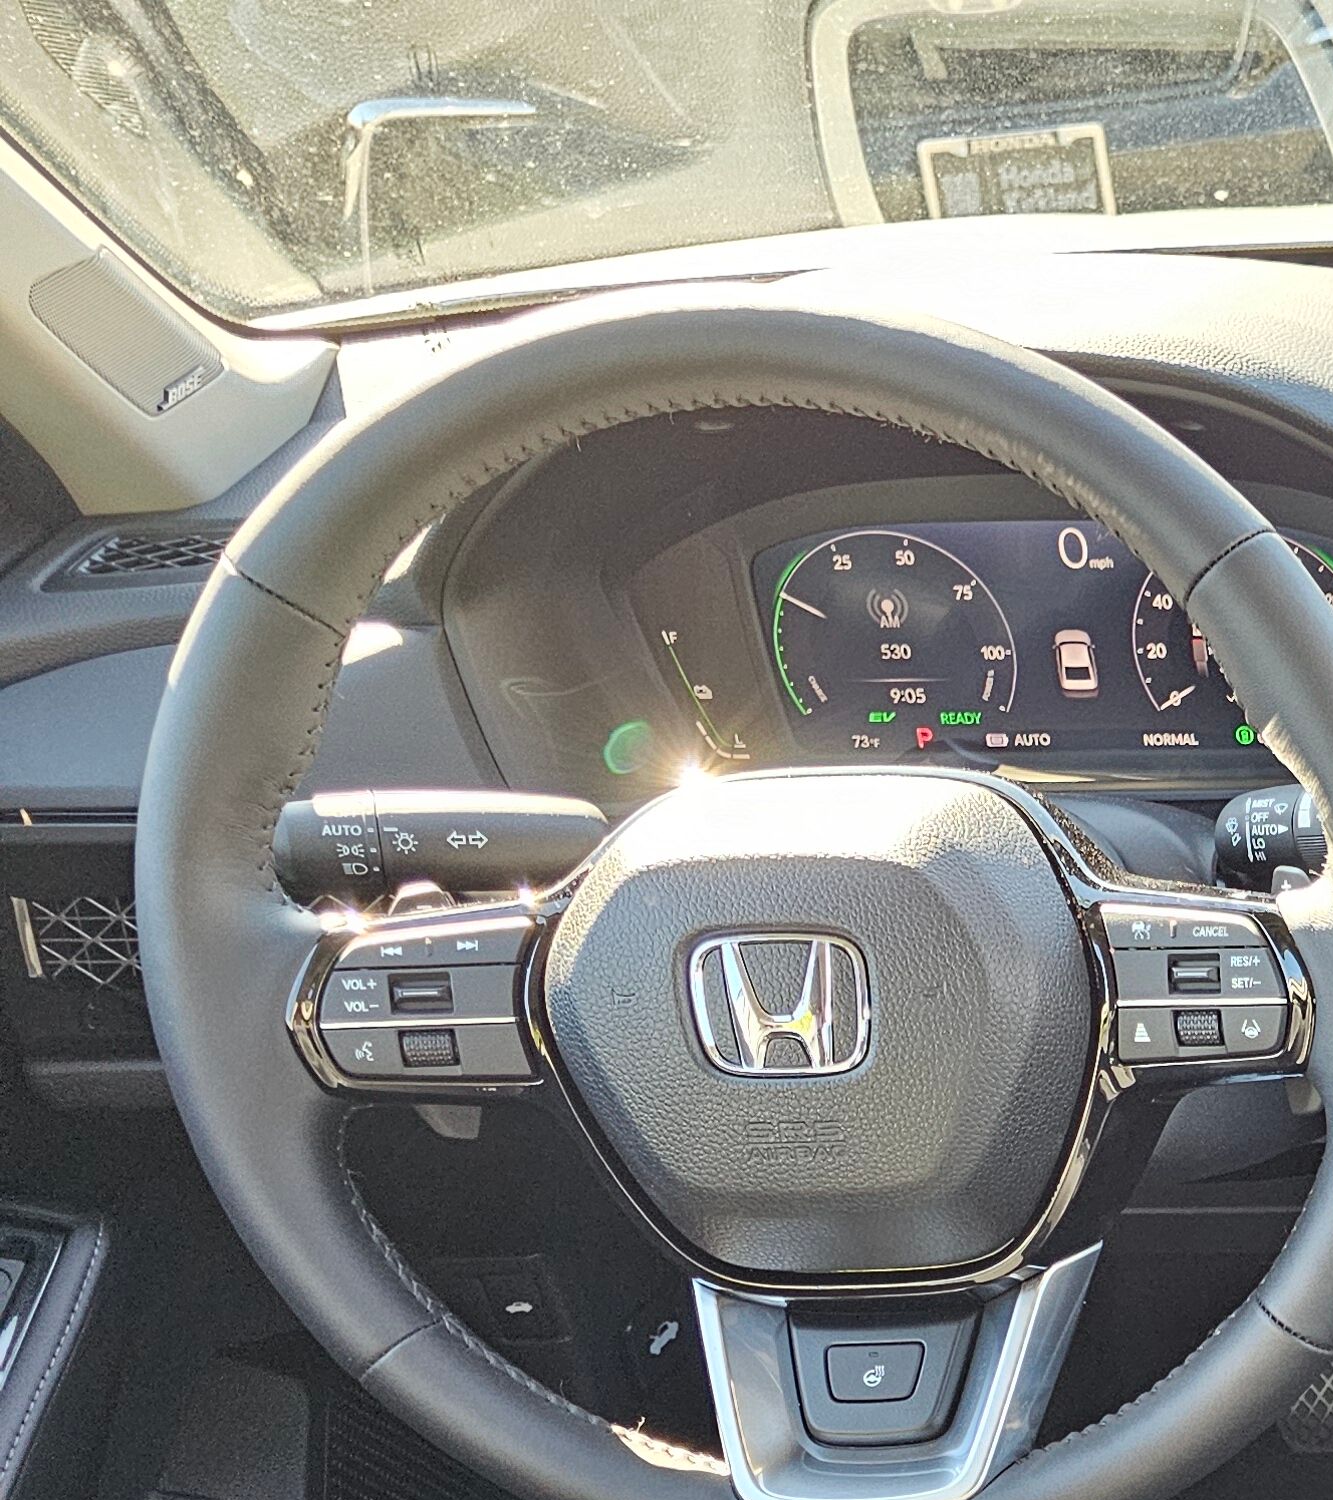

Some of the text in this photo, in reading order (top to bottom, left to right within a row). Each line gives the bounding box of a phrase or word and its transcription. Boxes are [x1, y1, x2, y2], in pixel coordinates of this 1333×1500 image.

[1058, 527, 1114, 571] 0 mph
[833, 555, 852, 571] 25
[895, 551, 915, 566] 50
[953, 585, 974, 601] 75
[1152, 593, 1173, 610] 40
[880, 616, 901, 629] AM
[668, 631, 678, 644] F
[880, 644, 912, 660] 530
[980, 646, 1005, 661] 100
[1146, 643, 1167, 659] 20
[890, 688, 927, 704] 9:05
[868, 711, 896, 723] EV
[939, 712, 982, 725] READY
[851, 735, 880, 749] 73°F
[916, 727, 934, 749] P
[1014, 733, 1051, 747] AUTO
[1143, 733, 1199, 746] NORMAL
[1251, 798, 1276, 809] MIST
[1250, 811, 1270, 823] OFF
[322, 825, 362, 836] AUTO
[1251, 823, 1278, 837] AUTO
[1252, 838, 1266, 850] LO
[1254, 851, 1267, 862] HI
[1192, 926, 1229, 938] CANCEL
[1230, 955, 1261, 968] RES/+
[341, 978, 377, 991] VOL+
